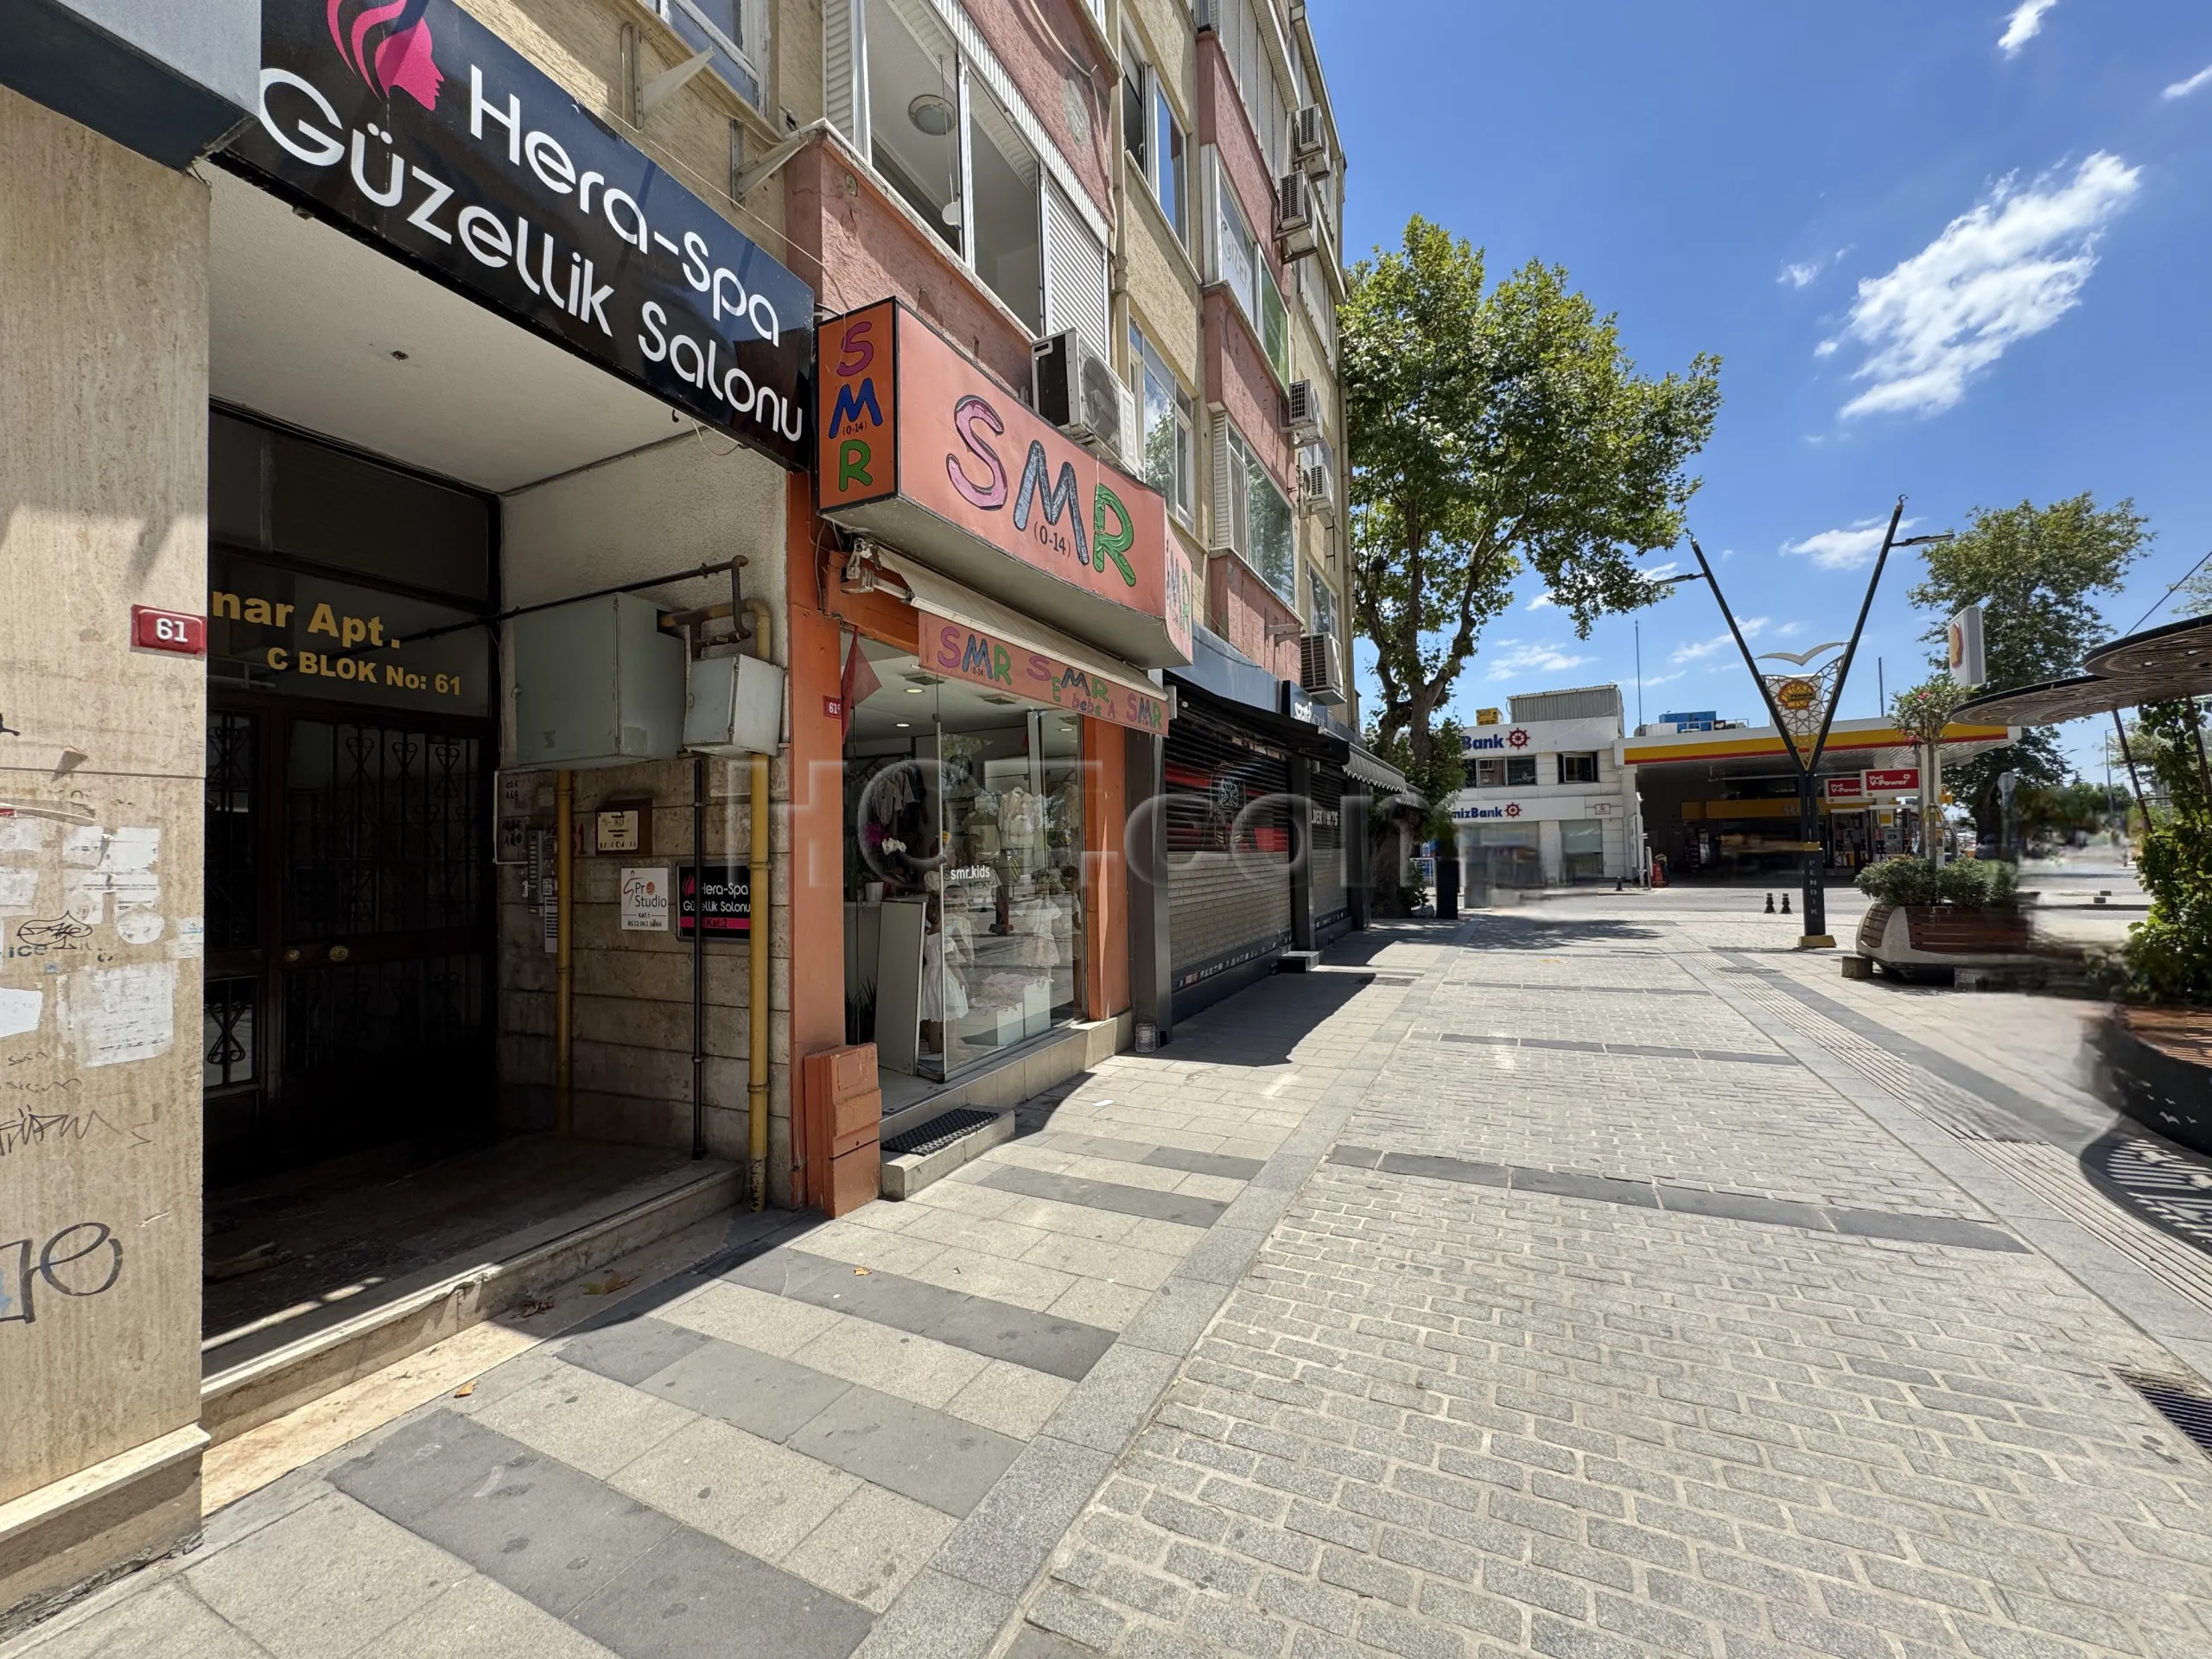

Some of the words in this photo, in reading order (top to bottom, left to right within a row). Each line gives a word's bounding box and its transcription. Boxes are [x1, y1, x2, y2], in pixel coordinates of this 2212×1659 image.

[470, 64, 779, 347] Hera-Spa
[259, 67, 614, 337] Güzellik
[638, 301, 803, 442] Salonu
[946, 394, 1136, 587] SMR
[1034, 521, 1071, 558] (0-14)
[156, 618, 188, 643] 61
[308, 602, 401, 649] Apt.
[267, 647, 288, 671] C
[299, 652, 378, 683] BLOK
[386, 666, 427, 690] No:
[435, 673, 461, 696] 61
[938, 626, 1013, 686] SMR
[1127, 692, 1162, 730] SMR
[1462, 734, 1504, 750] Bank
[635, 894, 667, 908] Studio
[683, 900, 718, 912] Güellik
[720, 900, 751, 913] Salonu
